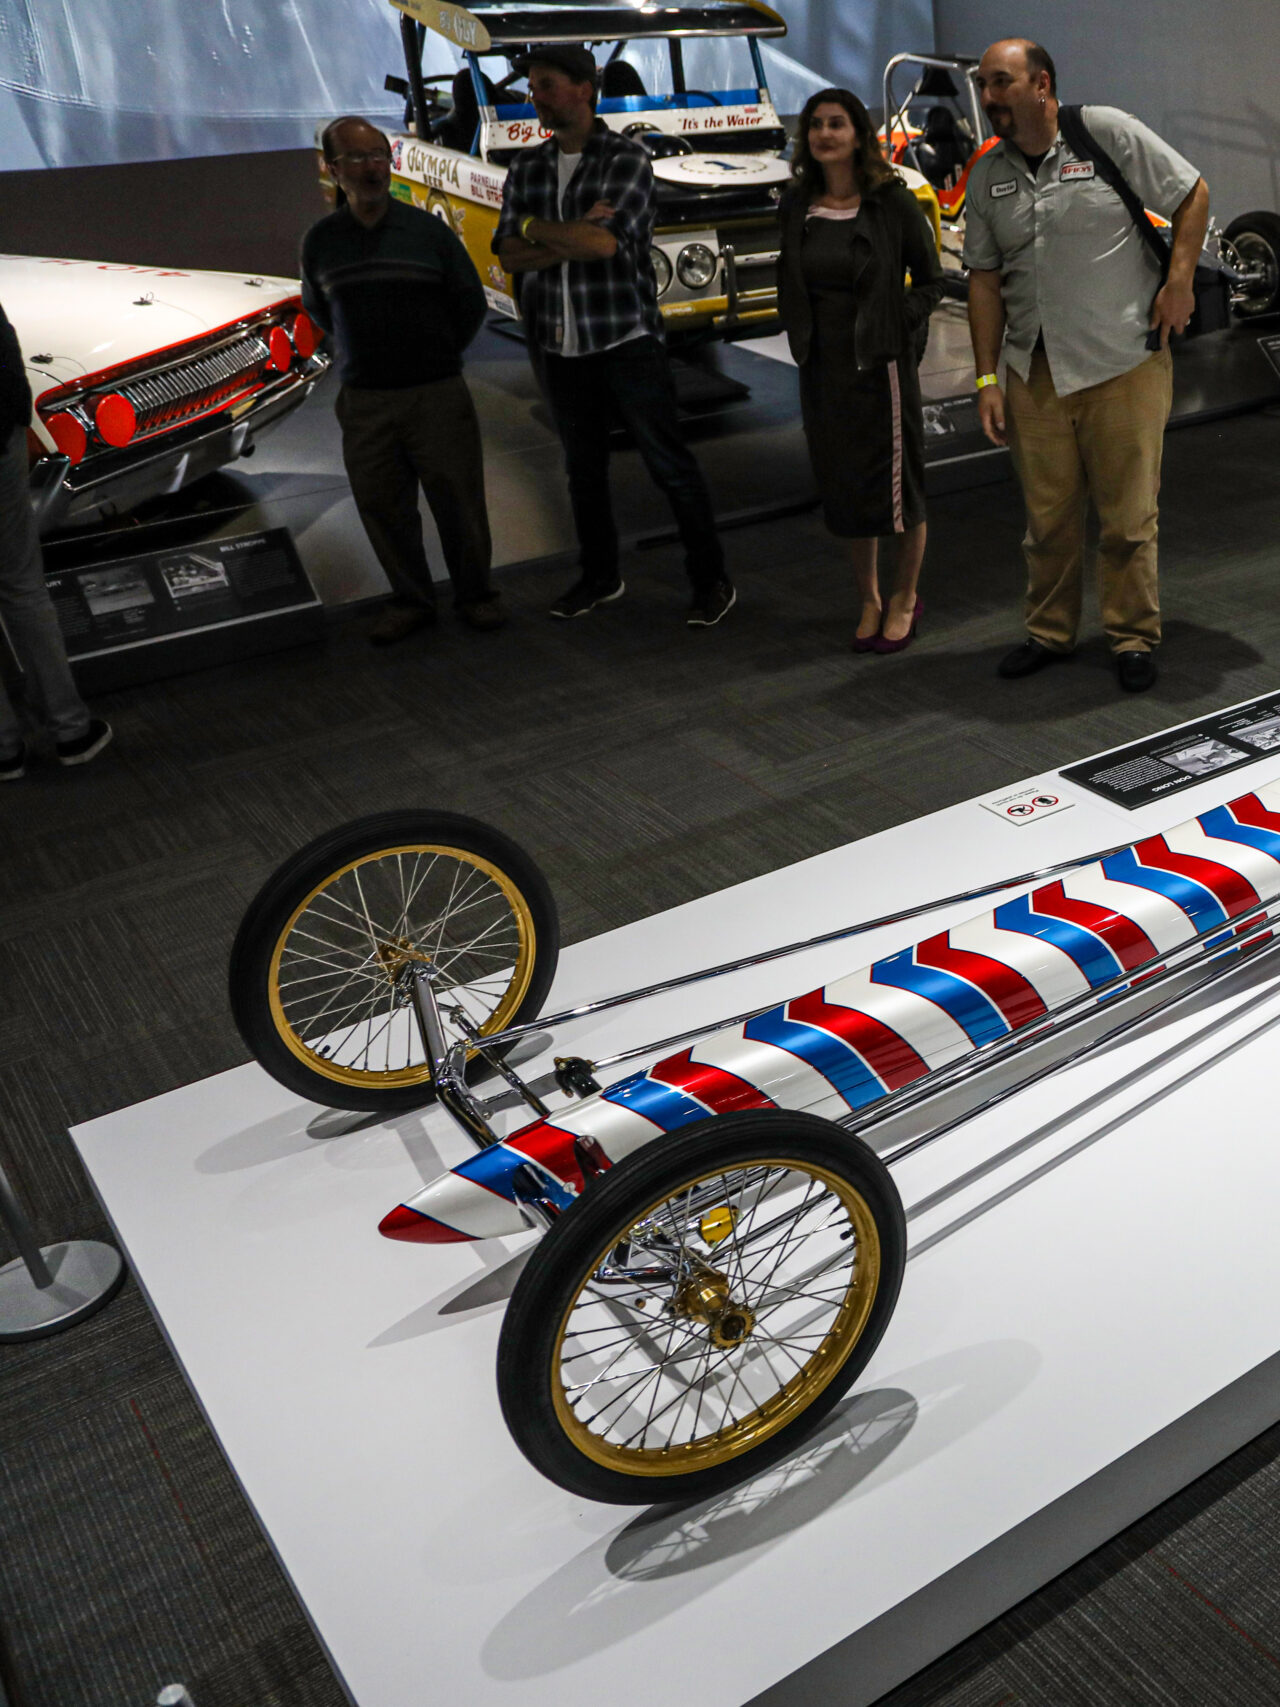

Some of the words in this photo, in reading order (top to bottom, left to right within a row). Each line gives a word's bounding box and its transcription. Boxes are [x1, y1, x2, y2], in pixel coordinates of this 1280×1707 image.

[704, 116, 723, 128] the
[407, 146, 460, 189] OLYMPIA
[422, 174, 444, 188] BEER
